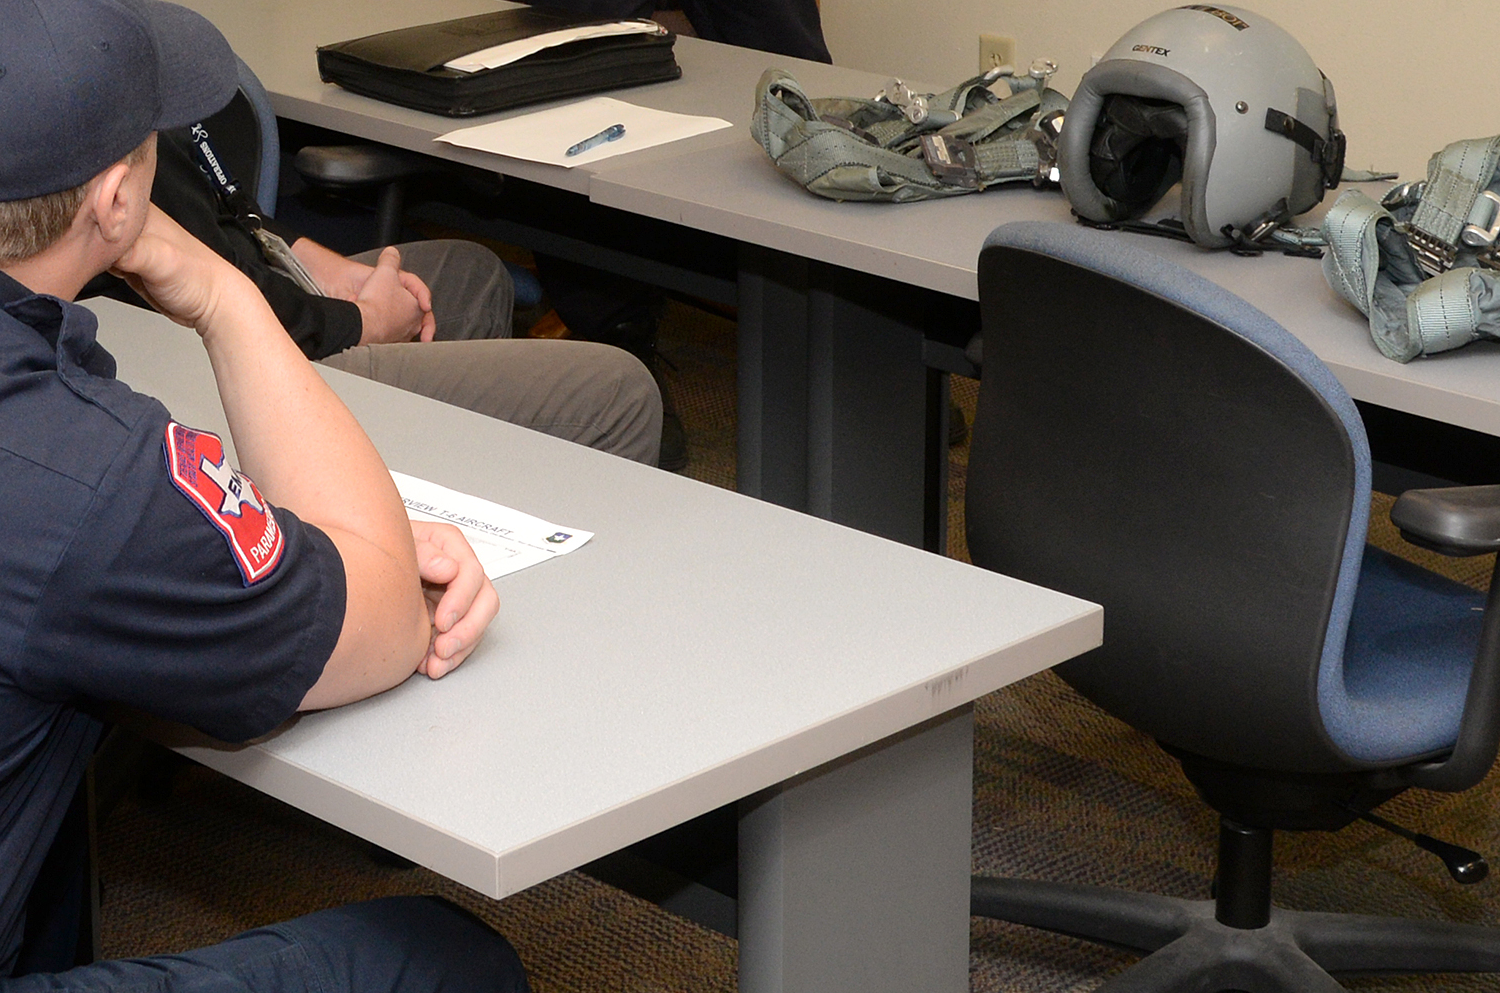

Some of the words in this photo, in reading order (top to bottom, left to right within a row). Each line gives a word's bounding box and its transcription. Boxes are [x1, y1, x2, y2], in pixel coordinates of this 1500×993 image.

[1132, 44, 1171, 57] GENTEX
[200, 141, 228, 185] OPERATIONS
[401, 497, 437, 513] RVIEW
[457, 515, 514, 536] AIRCRAFT
